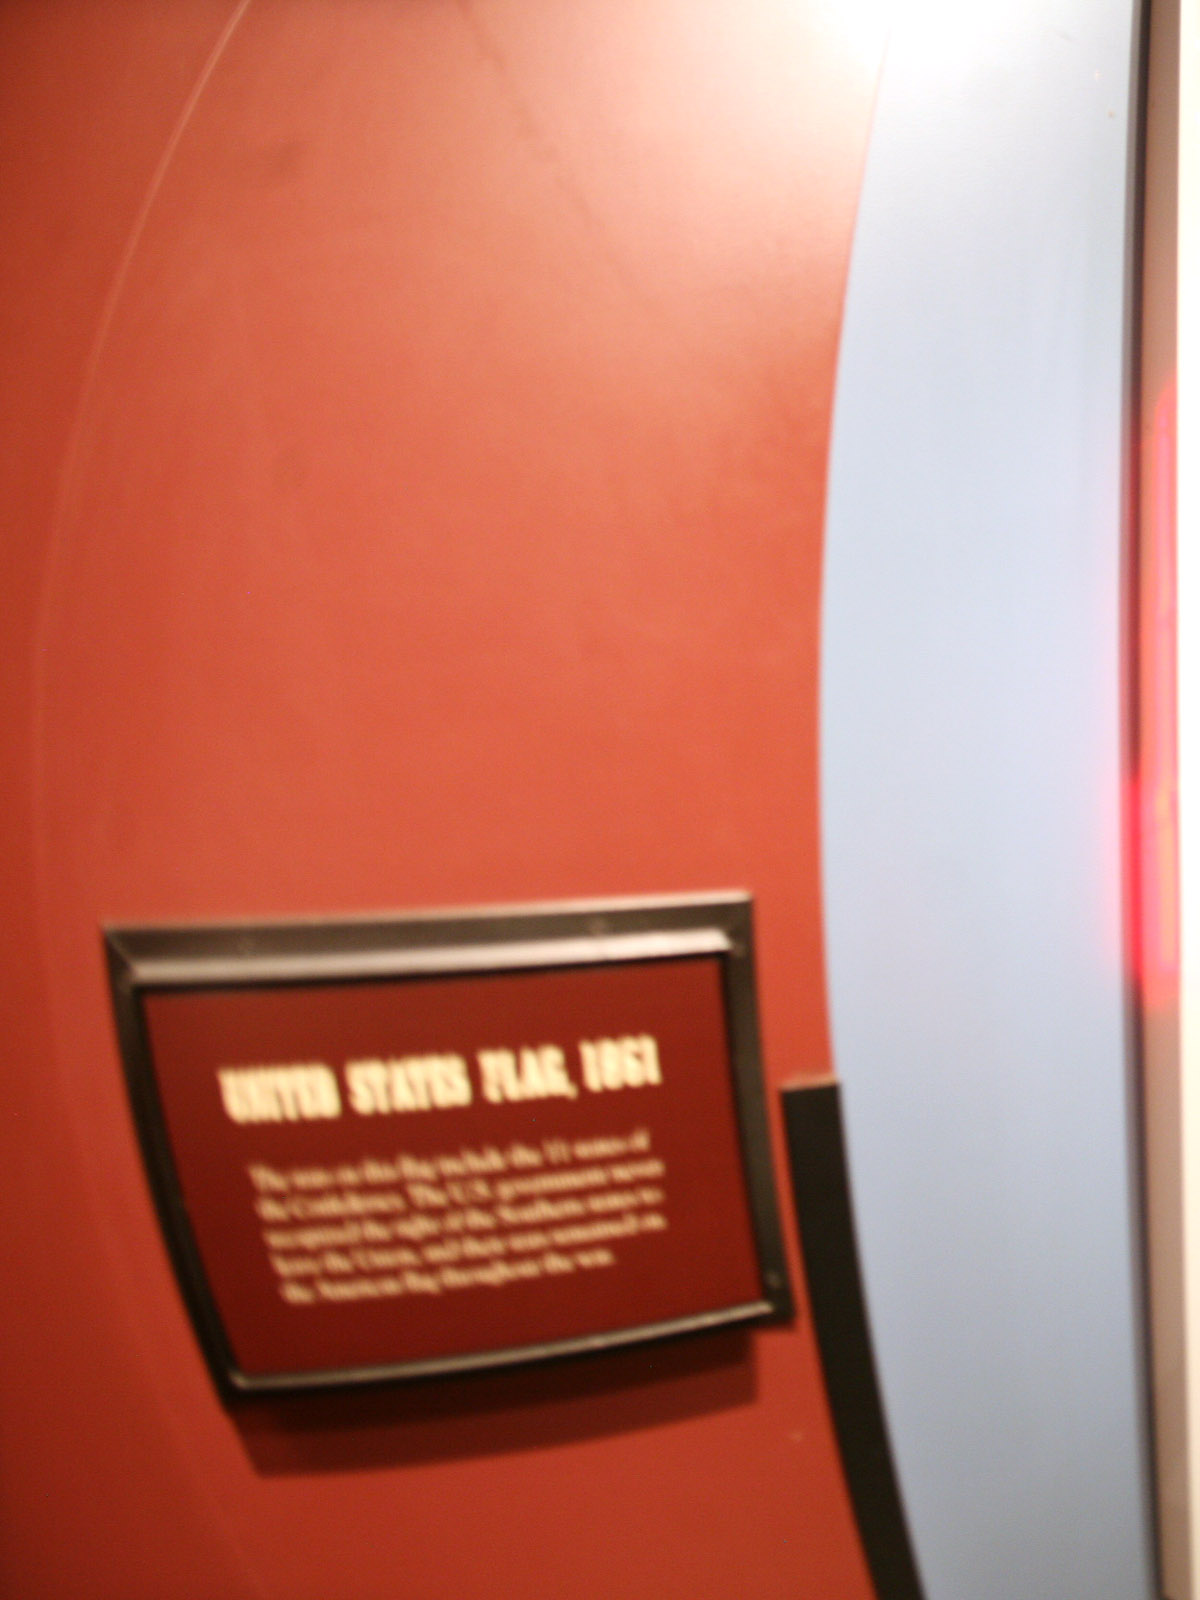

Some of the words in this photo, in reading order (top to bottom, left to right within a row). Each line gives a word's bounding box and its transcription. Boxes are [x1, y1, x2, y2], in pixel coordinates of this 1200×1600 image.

[217, 1063, 342, 1124] UNITED
[344, 1053, 472, 1115] STATES
[477, 1044, 577, 1102] FLAG,
